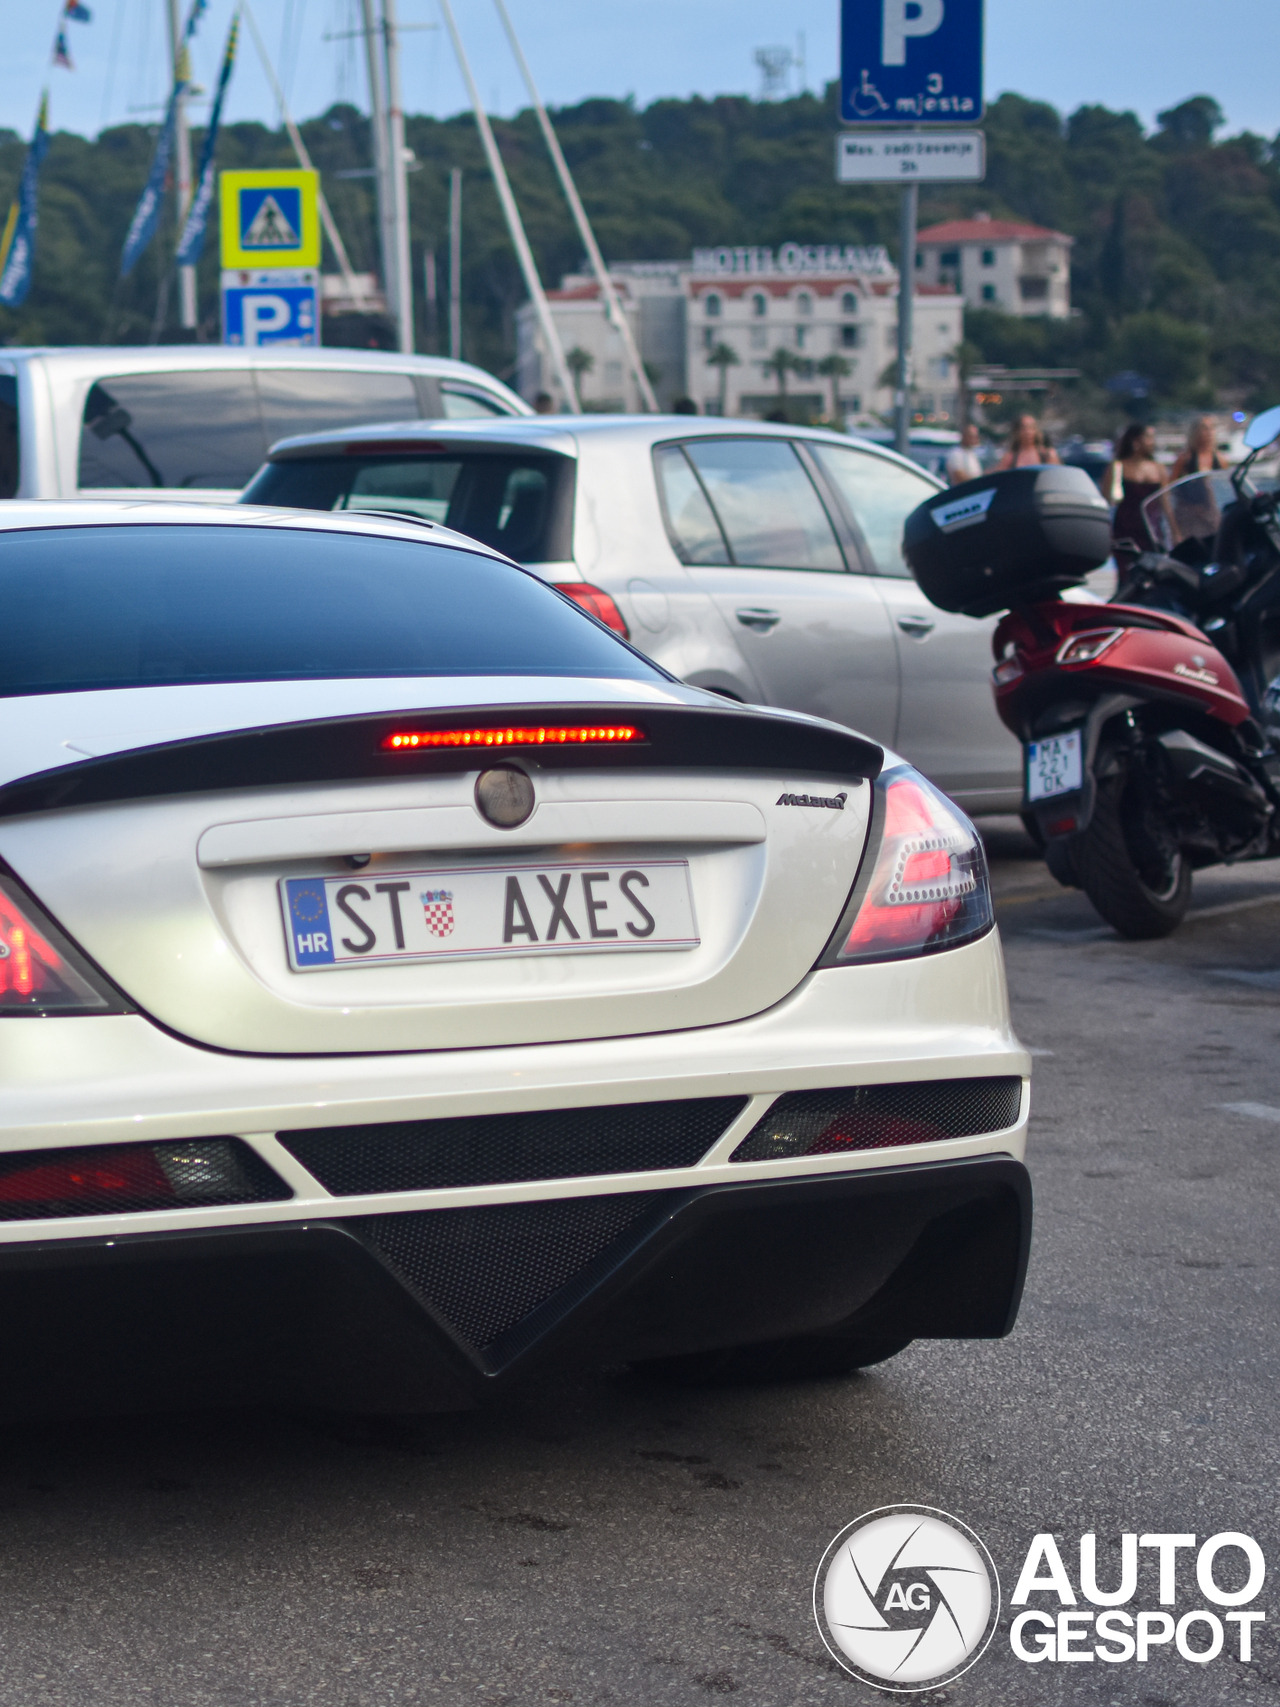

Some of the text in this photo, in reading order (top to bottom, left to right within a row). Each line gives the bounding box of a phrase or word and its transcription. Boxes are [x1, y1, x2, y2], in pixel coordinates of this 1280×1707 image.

[881, 0, 944, 66] P
[927, 73, 943, 94] 3
[896, 93, 974, 116] mjesta
[242, 294, 292, 346] P
[1039, 754, 1068, 777] 221
[775, 792, 848, 810] McLaren
[335, 869, 656, 954] ST AXES
[297, 932, 329, 954] HR
